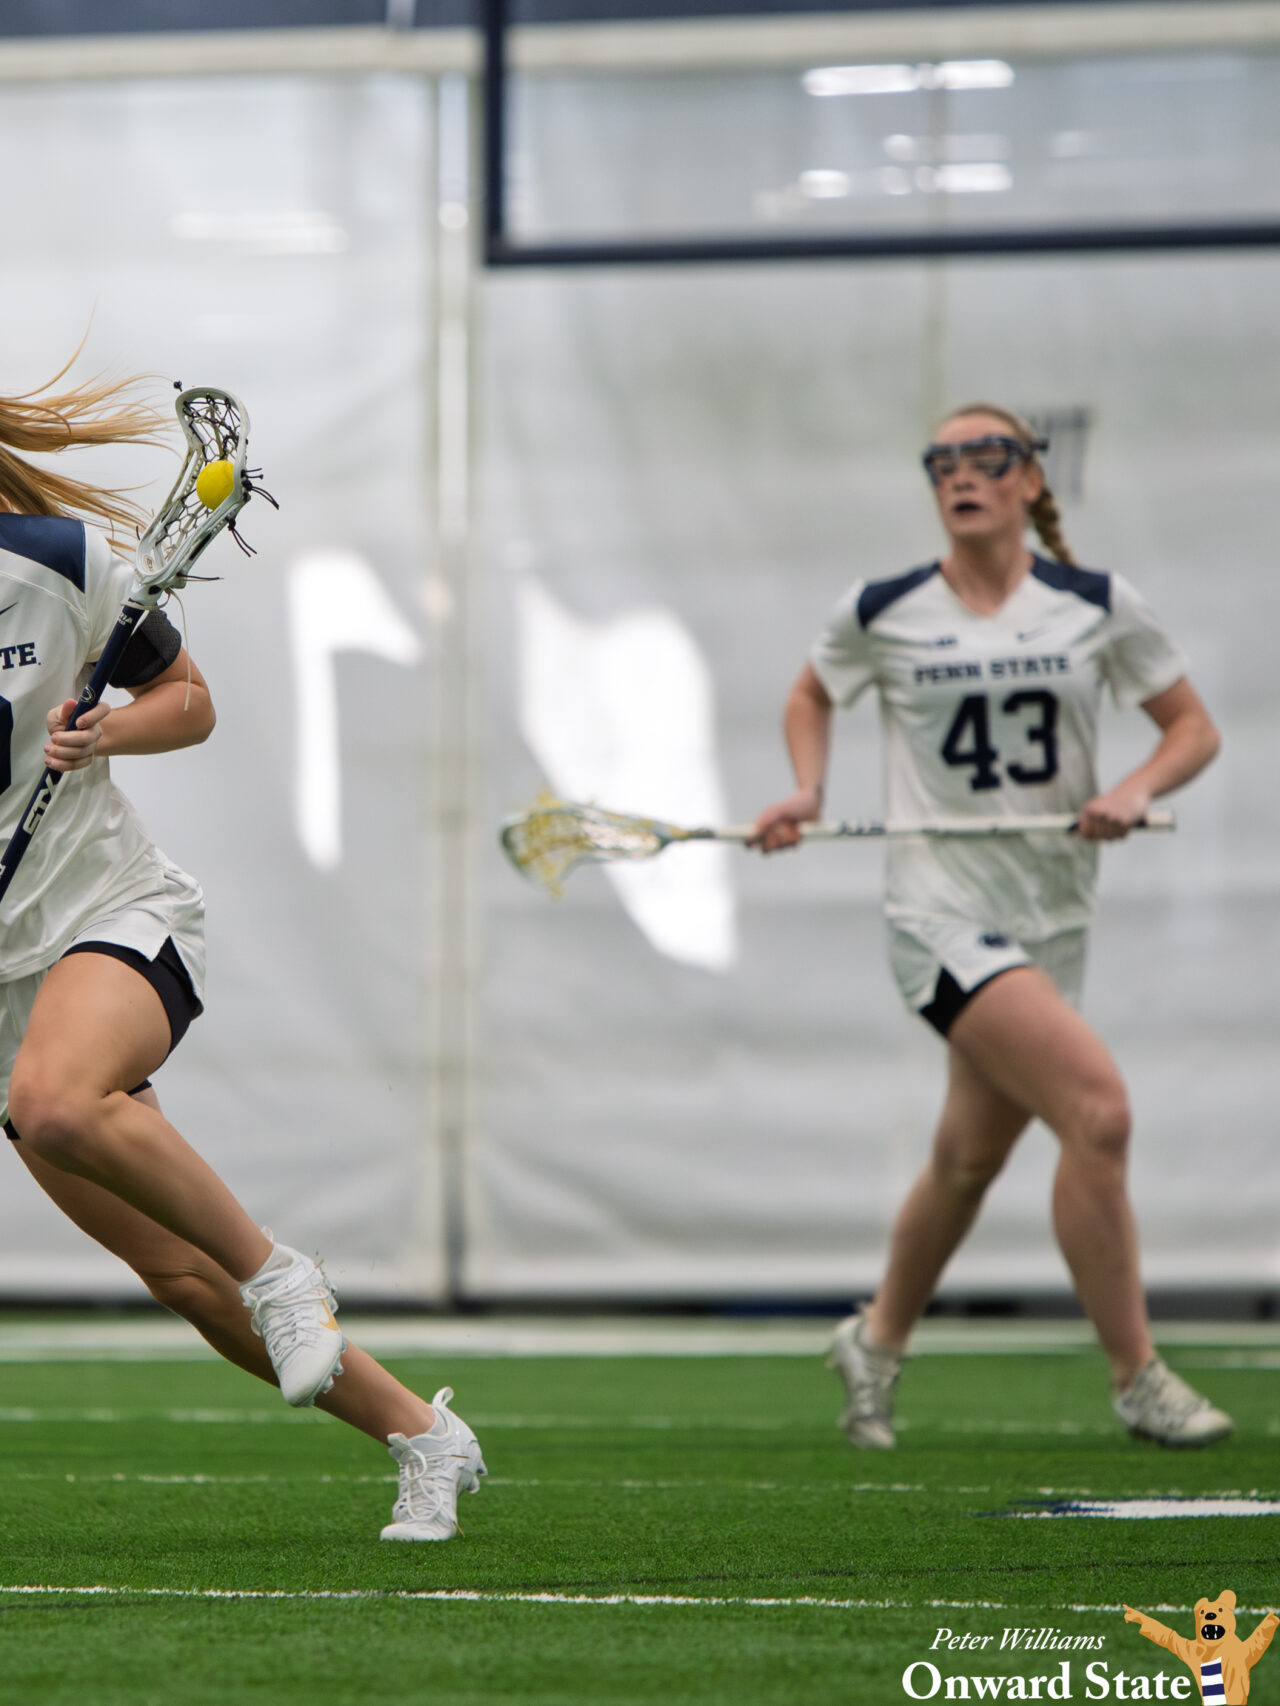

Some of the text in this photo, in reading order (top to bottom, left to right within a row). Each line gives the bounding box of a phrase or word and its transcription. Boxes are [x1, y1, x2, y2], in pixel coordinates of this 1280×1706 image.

[914, 654, 1070, 683] PENN STATE
[941, 687, 1060, 792] 43
